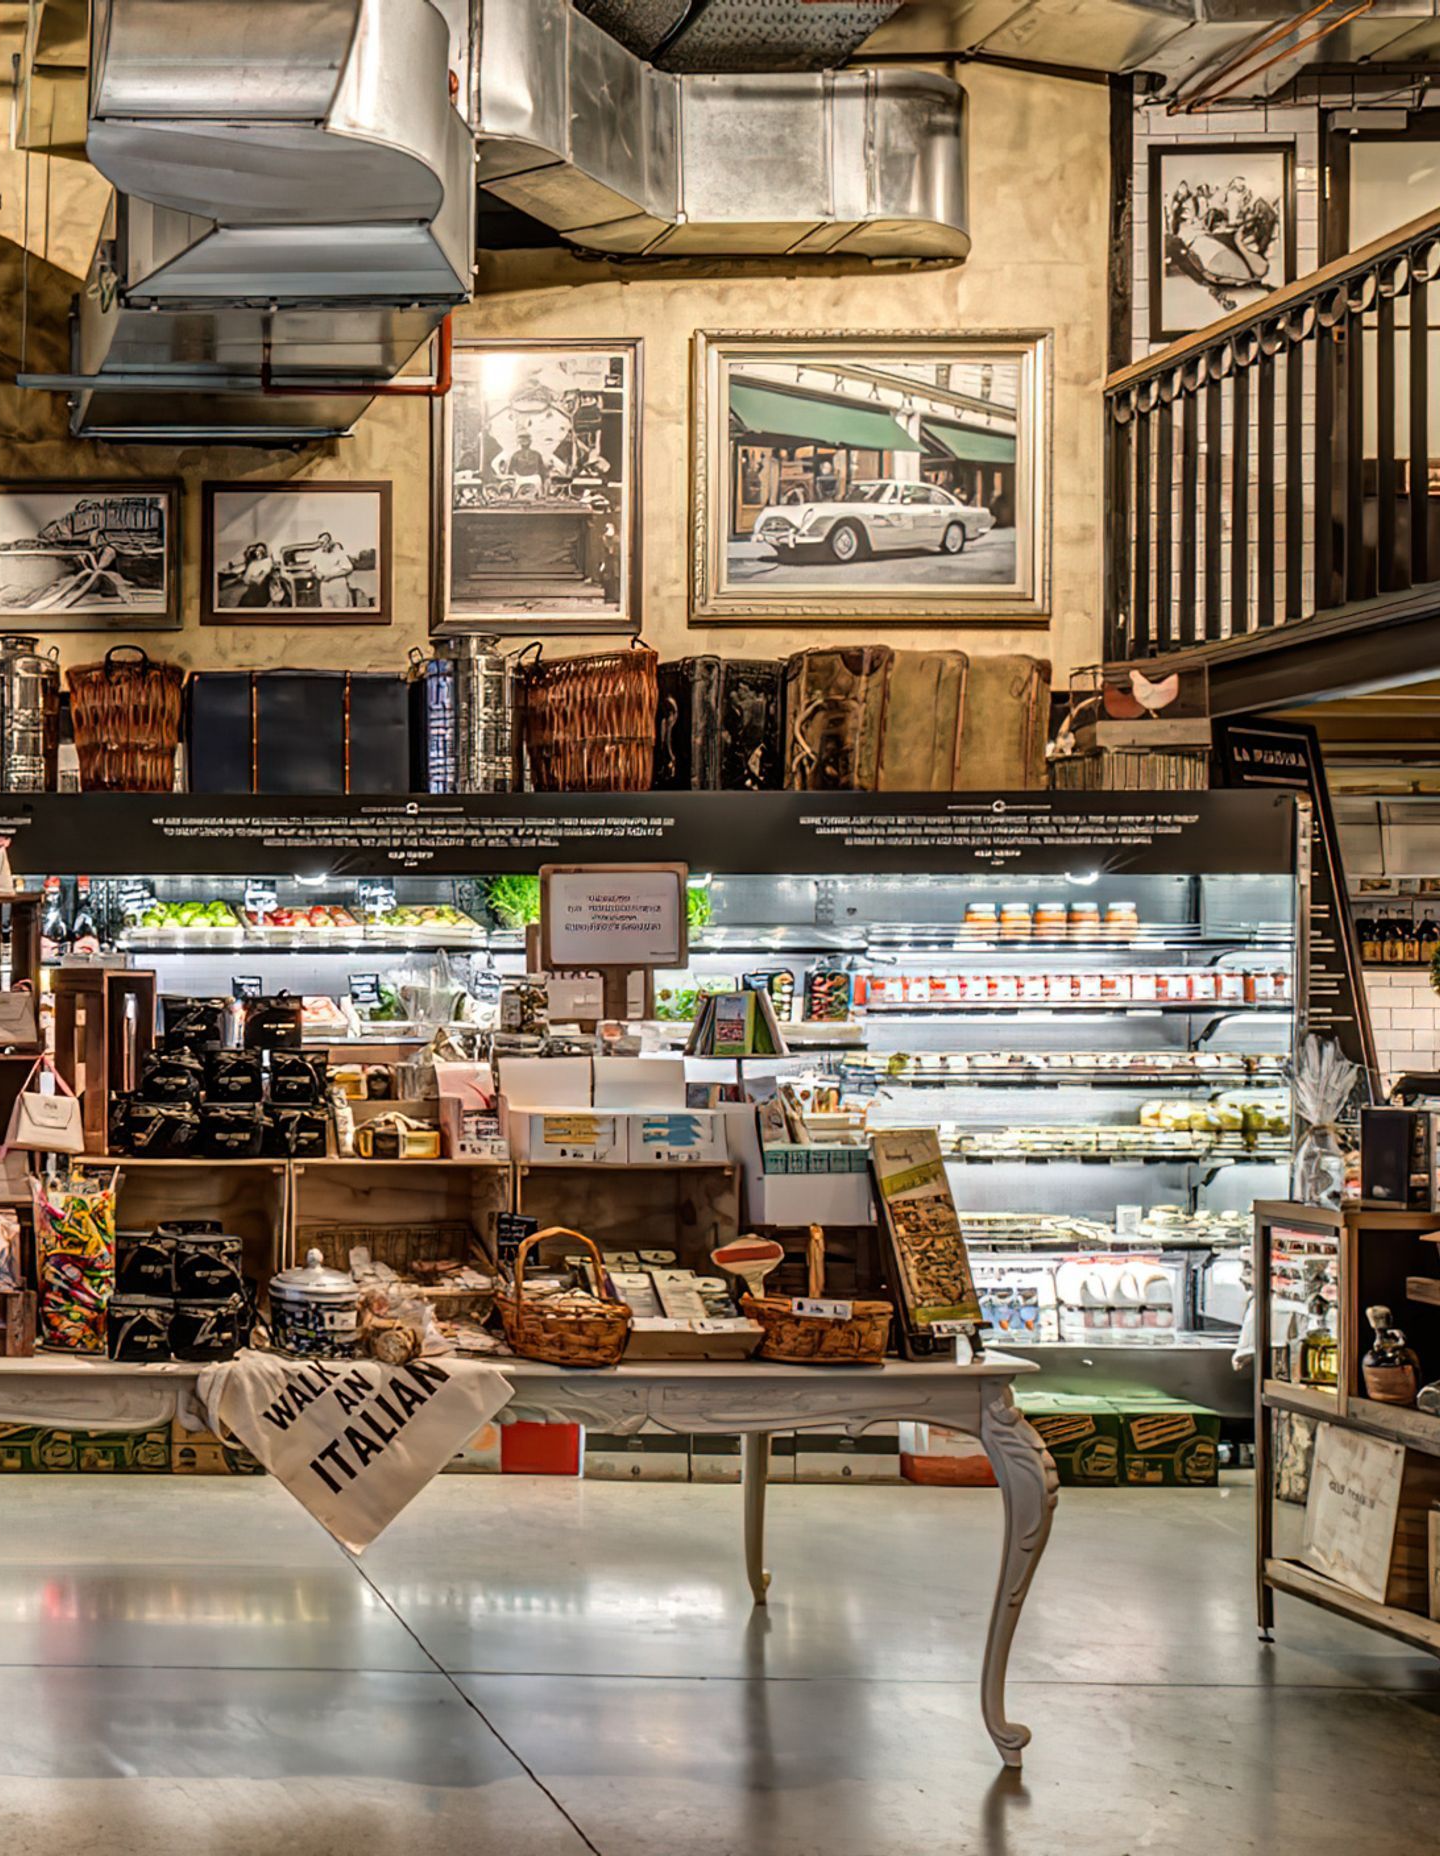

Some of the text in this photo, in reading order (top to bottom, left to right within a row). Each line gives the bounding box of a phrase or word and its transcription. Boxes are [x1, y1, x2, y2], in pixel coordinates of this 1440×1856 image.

[262, 1359, 340, 1431] WALK
[309, 1360, 451, 1495] ITALIAN
[333, 1368, 375, 1416] AN
